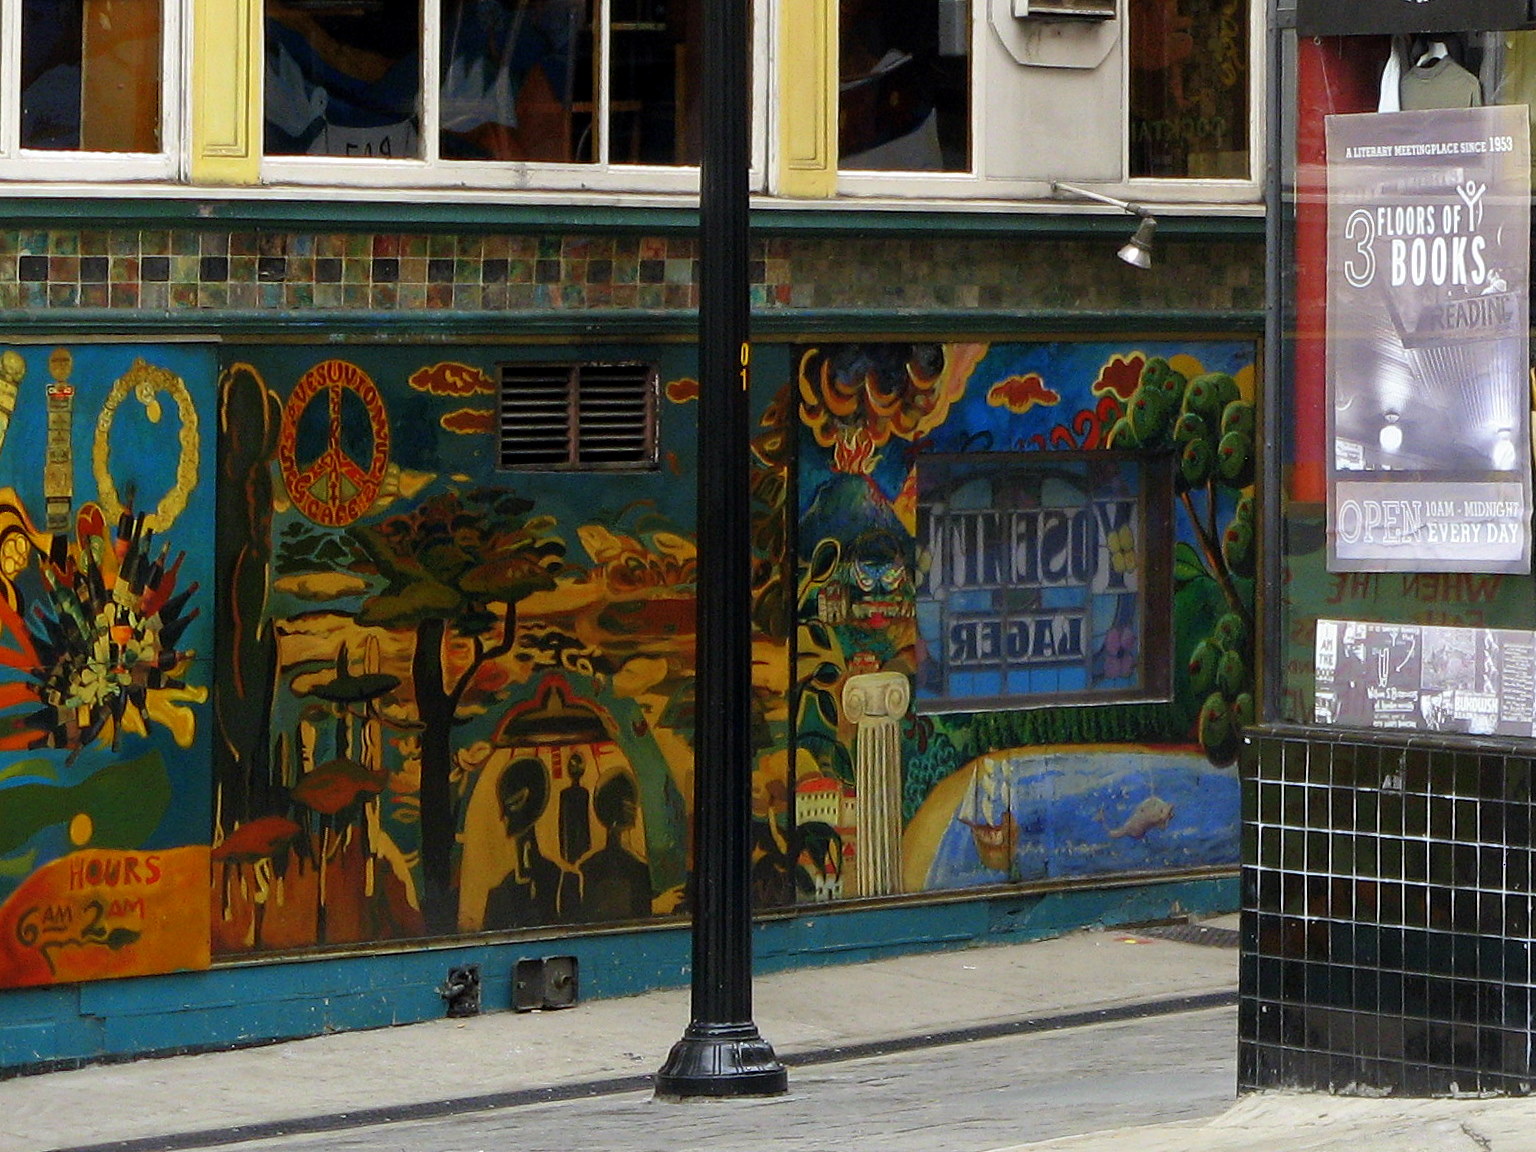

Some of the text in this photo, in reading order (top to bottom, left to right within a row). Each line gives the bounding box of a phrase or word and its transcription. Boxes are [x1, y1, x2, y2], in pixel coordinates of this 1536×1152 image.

[1345, 146, 1352, 159] A
[1353, 144, 1393, 158] LITERARY
[1460, 141, 1487, 153] SINCE
[1488, 135, 1513, 153] 1953
[1344, 205, 1462, 289] 3 FLOORS OF
[1390, 235, 1486, 287] BOOKS
[1338, 499, 1423, 544] OPEN
[1425, 500, 1454, 517] 10AM
[1464, 500, 1520, 518] MIDNIGHT
[1427, 522, 1519, 544] EVERY DAY
[69, 855, 162, 891] HOURS
